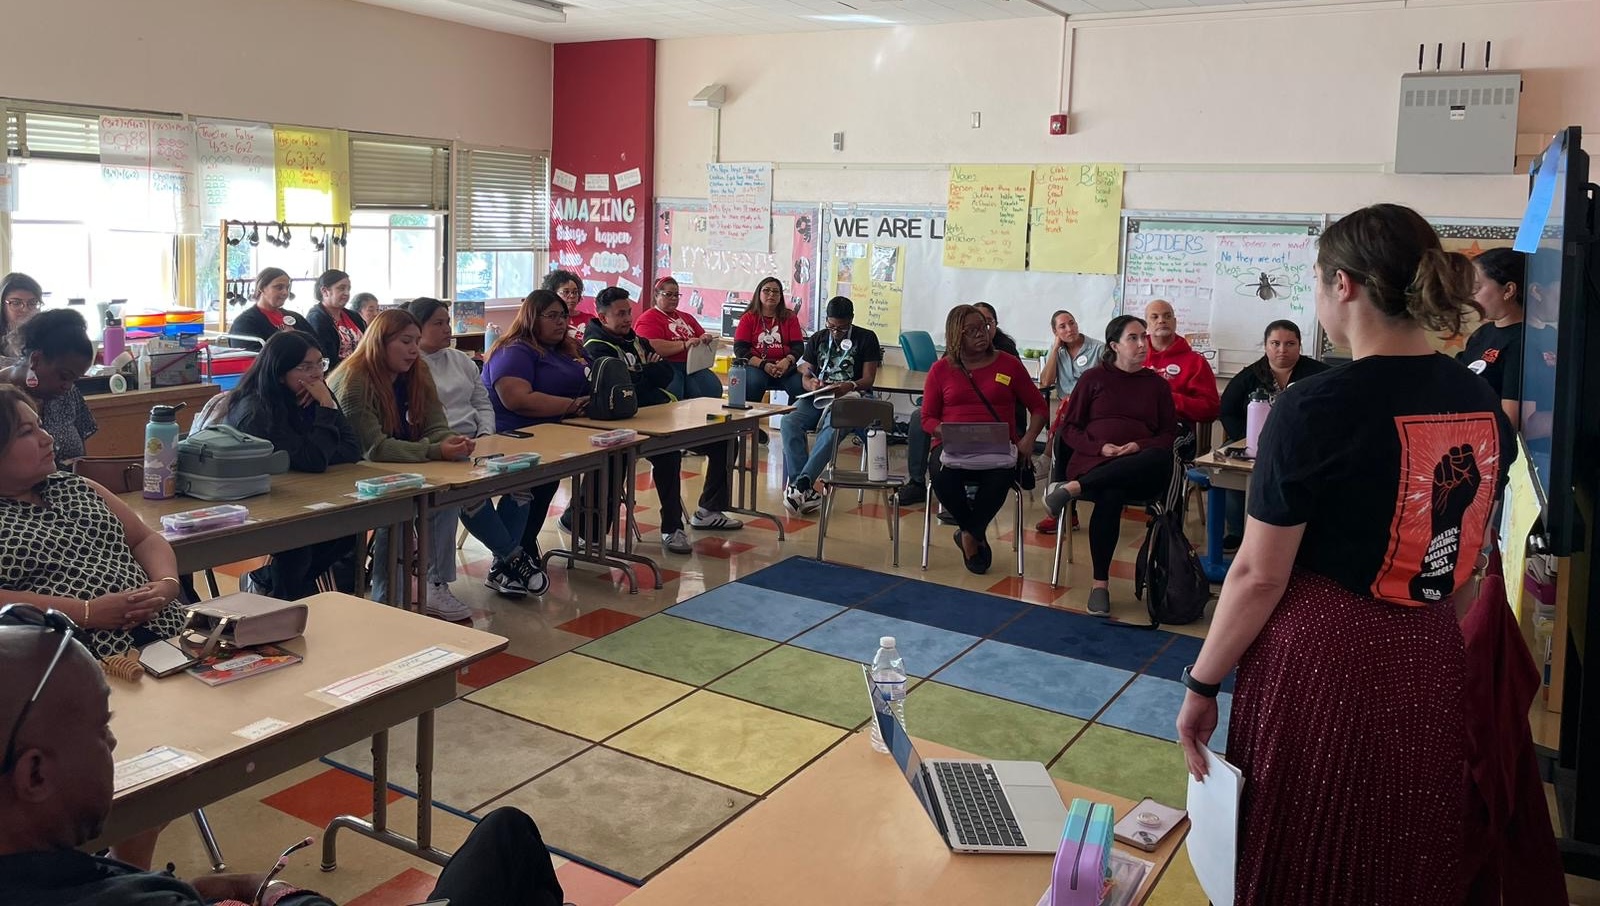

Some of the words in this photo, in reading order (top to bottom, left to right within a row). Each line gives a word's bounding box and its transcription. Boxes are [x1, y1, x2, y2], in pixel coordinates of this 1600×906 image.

[552, 197, 636, 223] AMAZING
[595, 226, 632, 249] happen
[834, 217, 869, 237] WE
[877, 217, 922, 238] ARE
[930, 218, 946, 239] L
[1134, 233, 1204, 252] SPIDERS
[1220, 251, 1232, 262] No
[1236, 250, 1254, 266] they
[1257, 256, 1271, 264] are
[1424, 543, 1458, 564] RACIALLY
[1430, 555, 1449, 570] JUST
[1420, 562, 1455, 578] SCHOOLS
